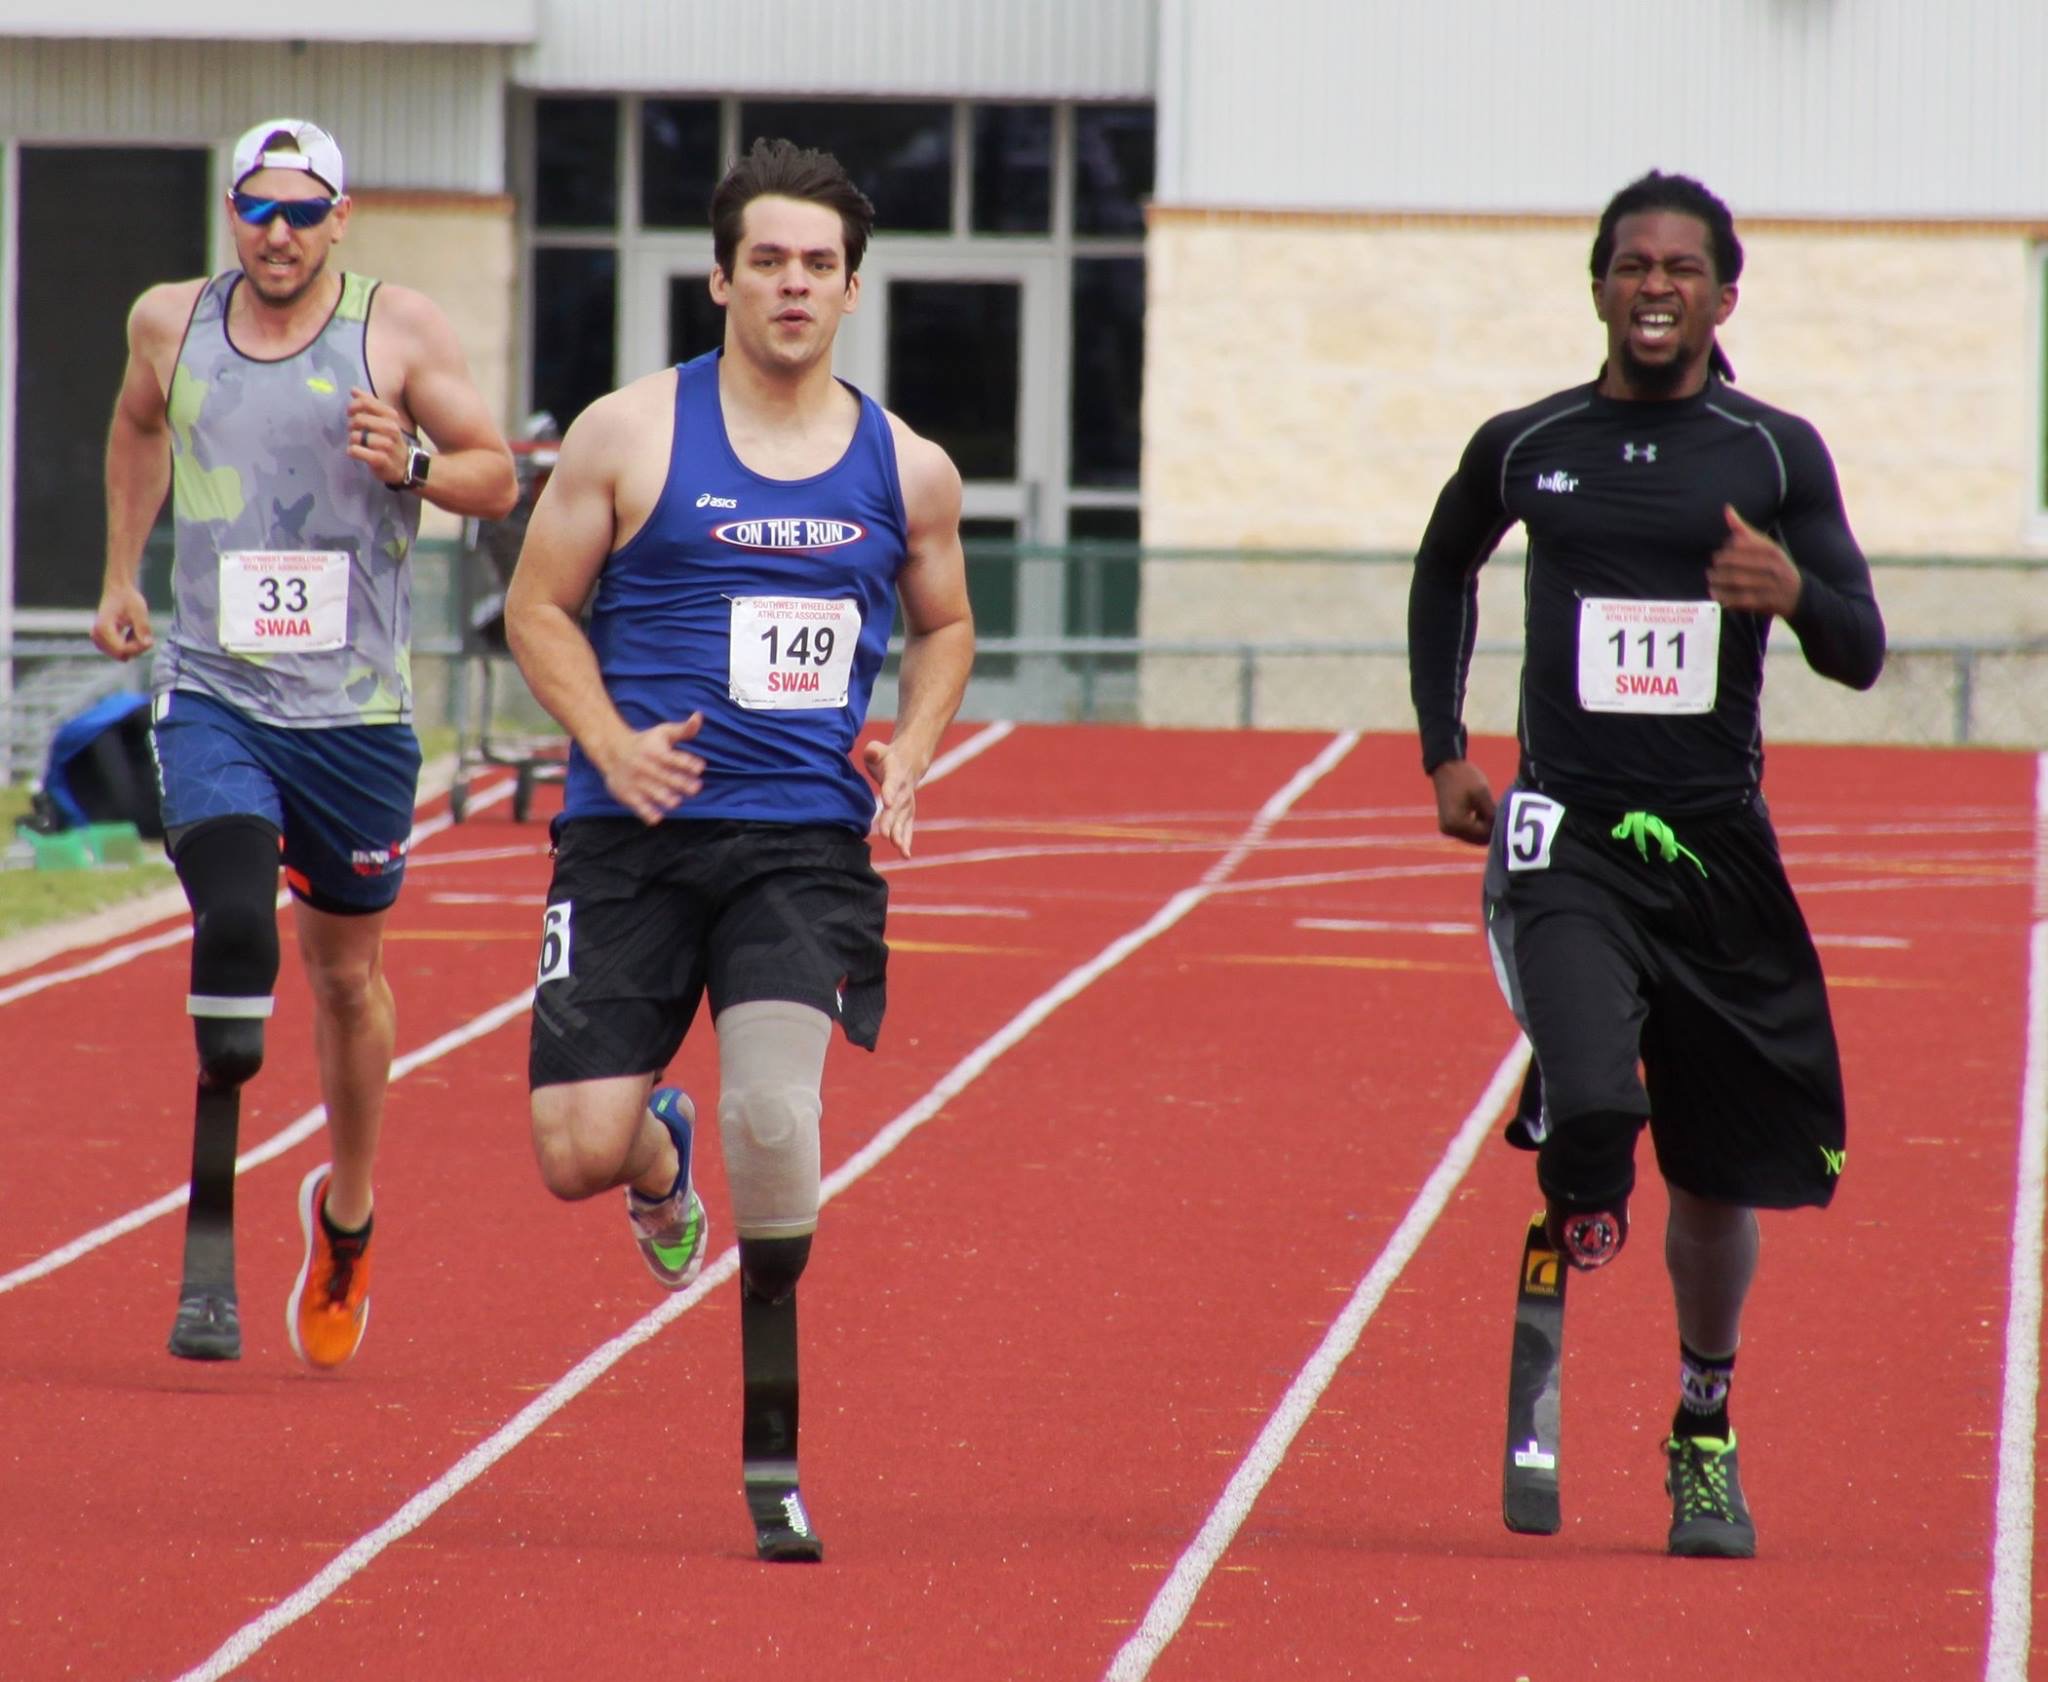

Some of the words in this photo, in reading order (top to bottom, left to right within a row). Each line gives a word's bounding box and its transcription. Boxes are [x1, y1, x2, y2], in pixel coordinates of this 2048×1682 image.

[709, 496, 737, 509] asics
[736, 522, 763, 545] ON
[768, 520, 800, 546] THE
[806, 521, 843, 545] RUN
[258, 577, 309, 613] 33
[752, 600, 799, 610] SOUTHWEST
[800, 602, 845, 611] WHEELCHAIR
[254, 618, 312, 637] SWAA
[757, 610, 793, 620] ATHLETIC
[794, 611, 841, 621] ASSOCIATION
[760, 625, 835, 666] 149
[1608, 629, 1685, 669] 111
[767, 671, 820, 692] SWAA
[1616, 674, 1679, 696] SWAA
[1512, 800, 1553, 863] 5
[540, 910, 562, 977] 6
